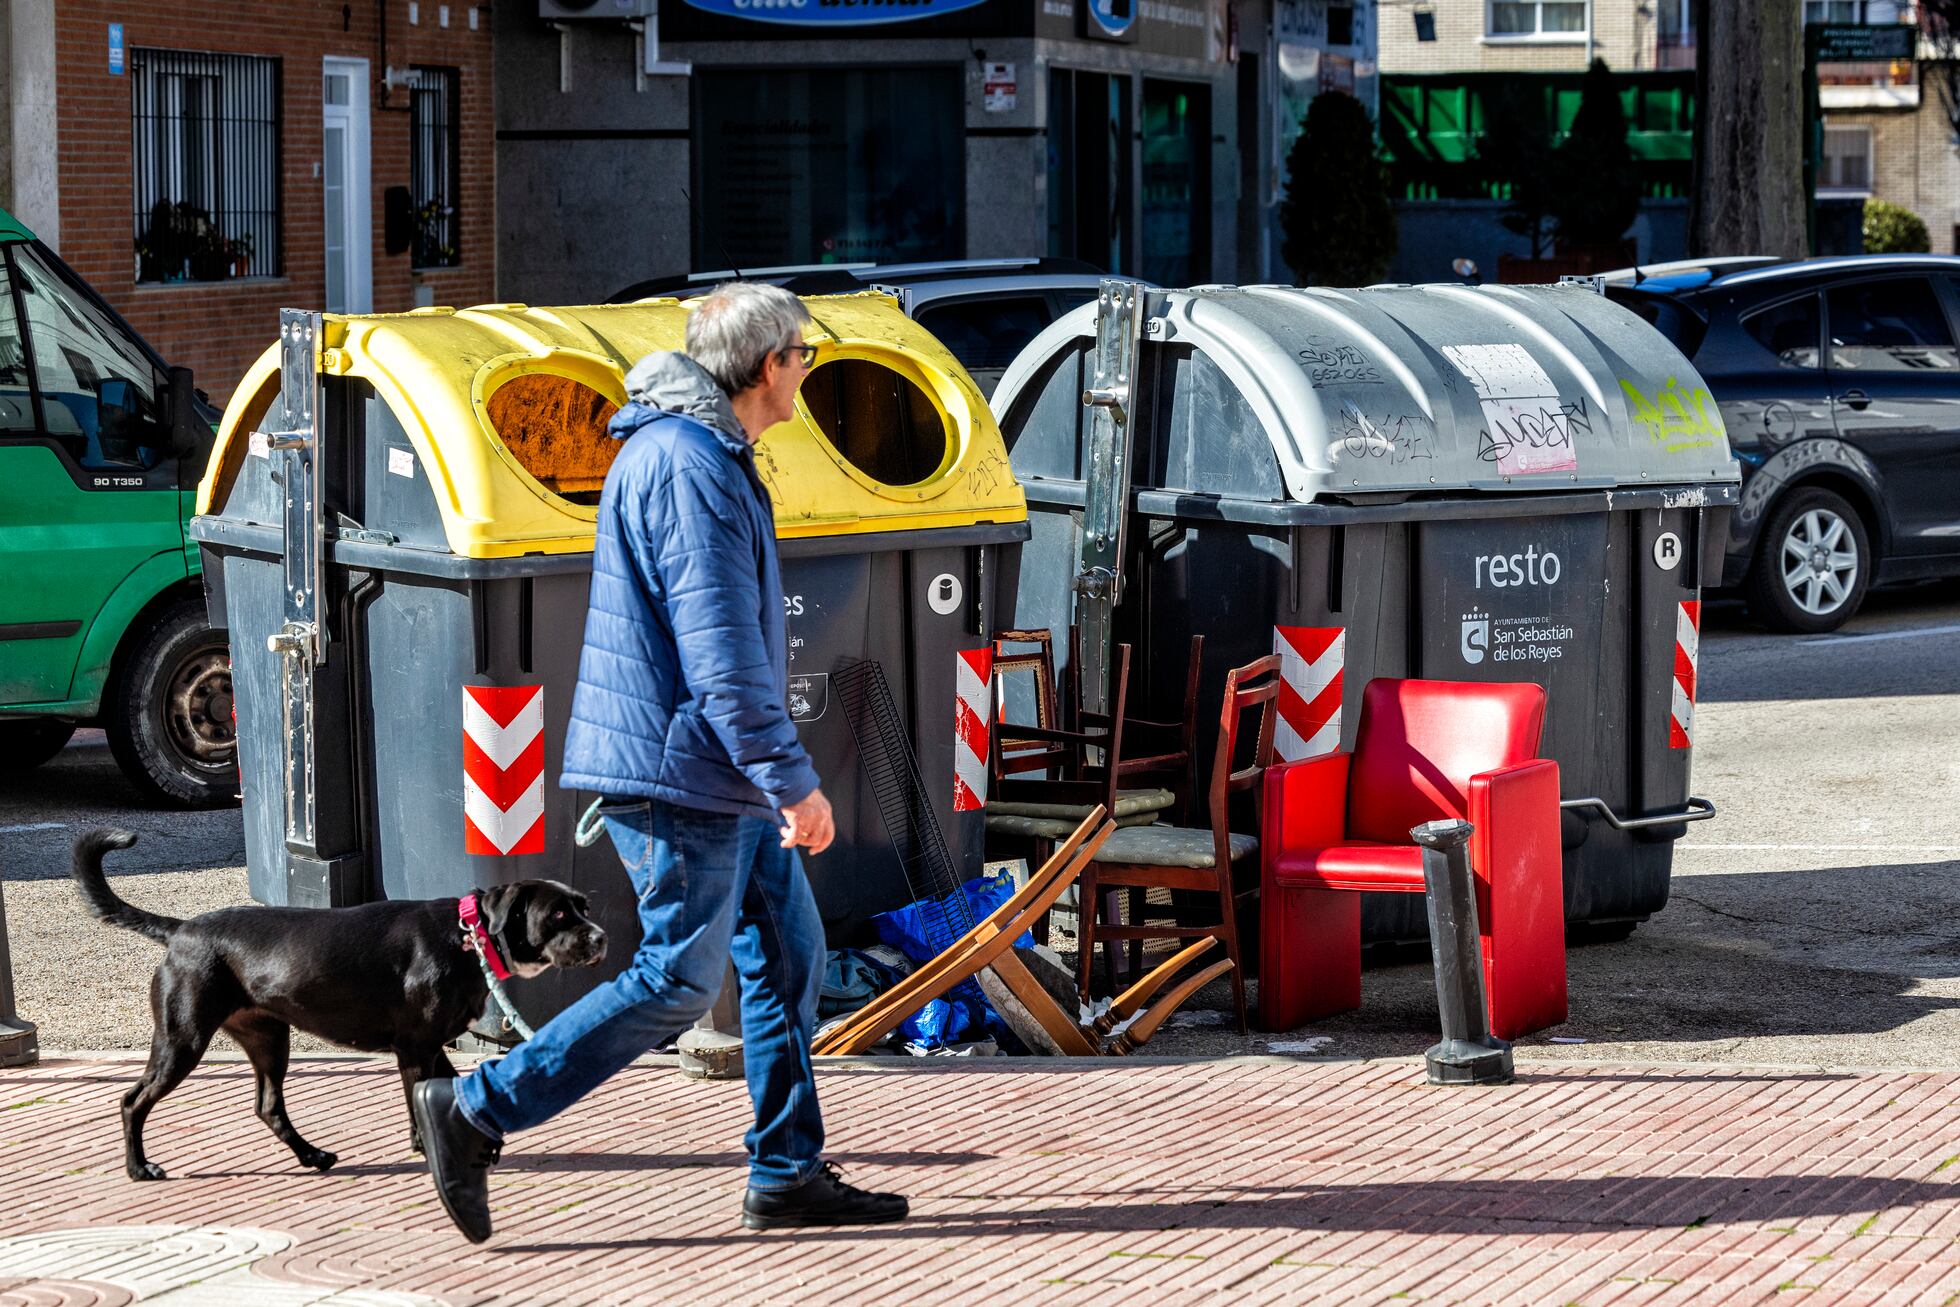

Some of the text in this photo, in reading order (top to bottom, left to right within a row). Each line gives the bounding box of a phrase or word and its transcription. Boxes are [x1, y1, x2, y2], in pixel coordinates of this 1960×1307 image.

[94, 477, 143, 486] 90 T350
[1662, 537, 1675, 558] R
[1475, 544, 1561, 589] resto
[1493, 616, 1540, 626] AYUNTAMIENTO
[1494, 624, 1573, 644] San Sebastián
[1493, 643, 1562, 663] de los Reyes
